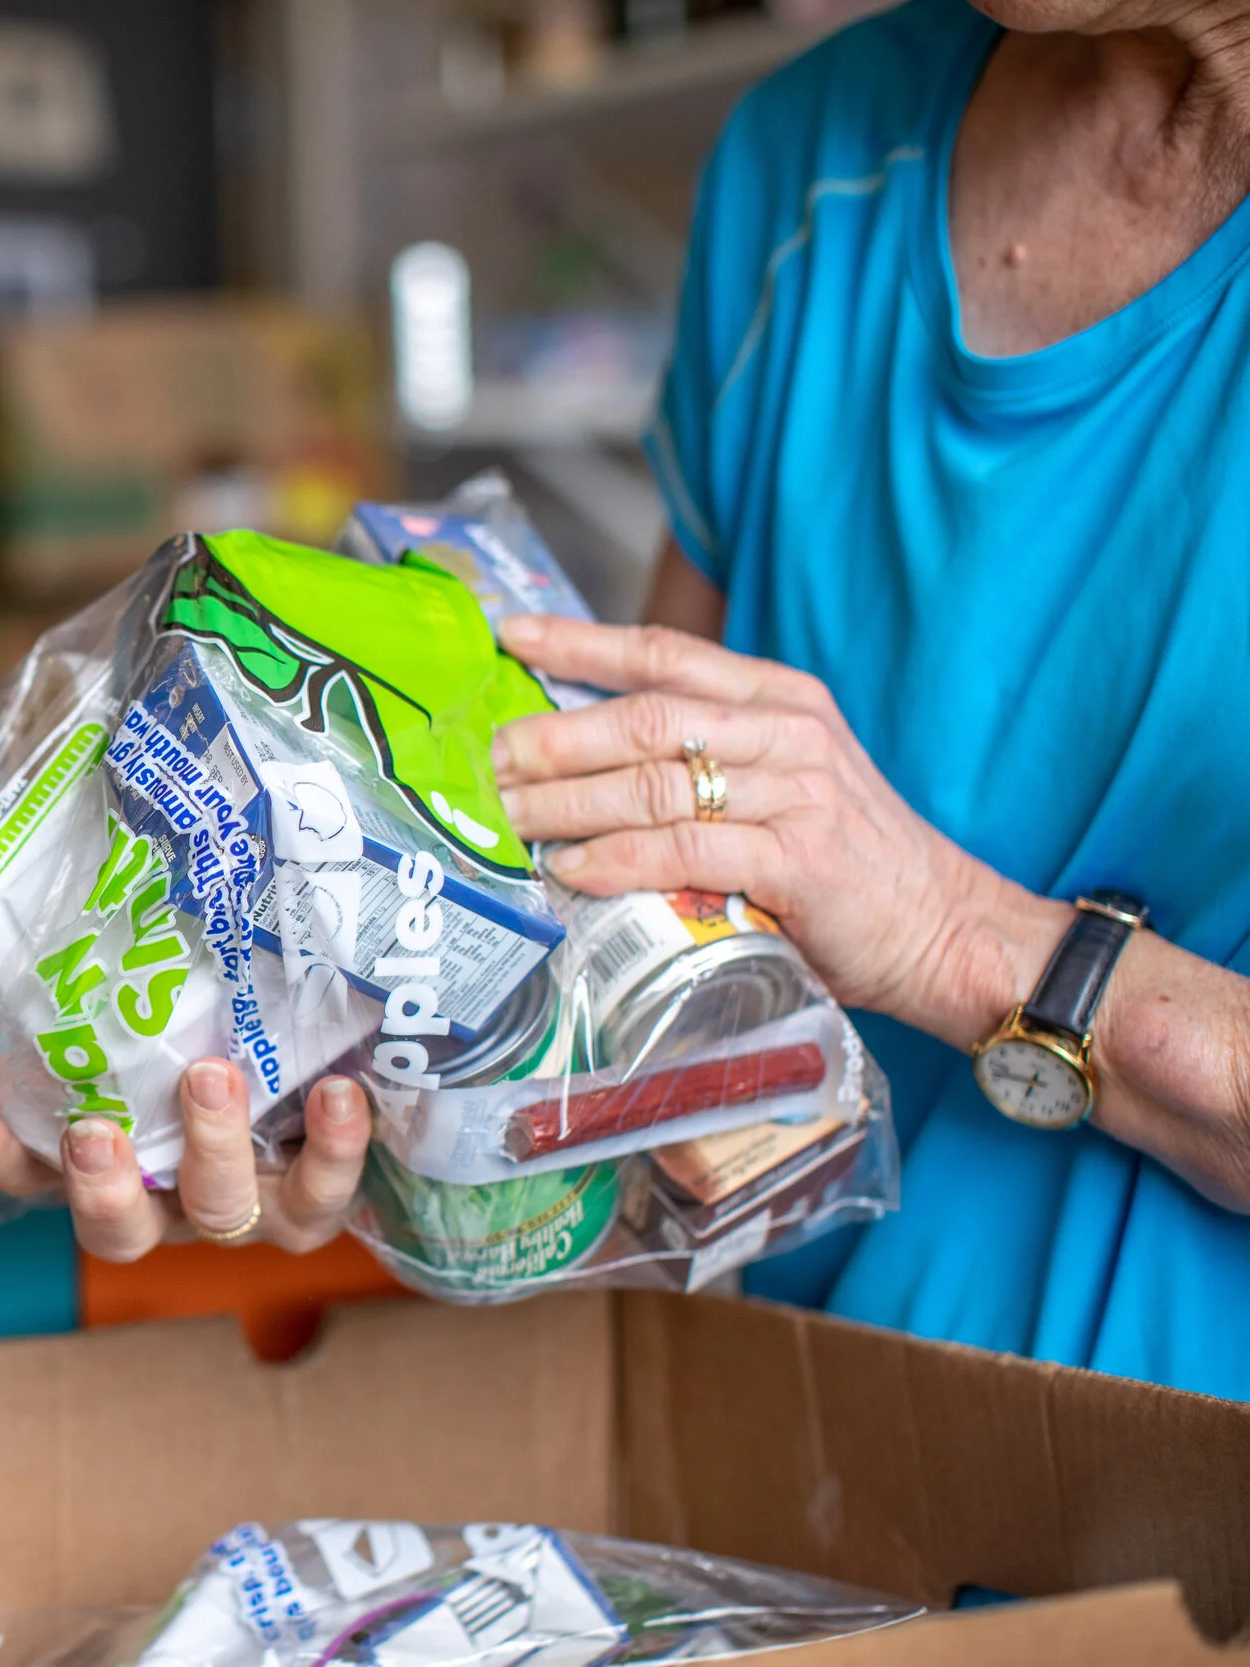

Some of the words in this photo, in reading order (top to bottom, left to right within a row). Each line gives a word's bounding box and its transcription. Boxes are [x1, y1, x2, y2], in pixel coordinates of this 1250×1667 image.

[144, 730, 203, 786] mouth
[230, 758, 244, 778] USED
[239, 775, 249, 787] BY
[122, 753, 203, 830] amously
[194, 785, 242, 842] your
[159, 834, 177, 862] SERVE
[193, 829, 225, 894] This
